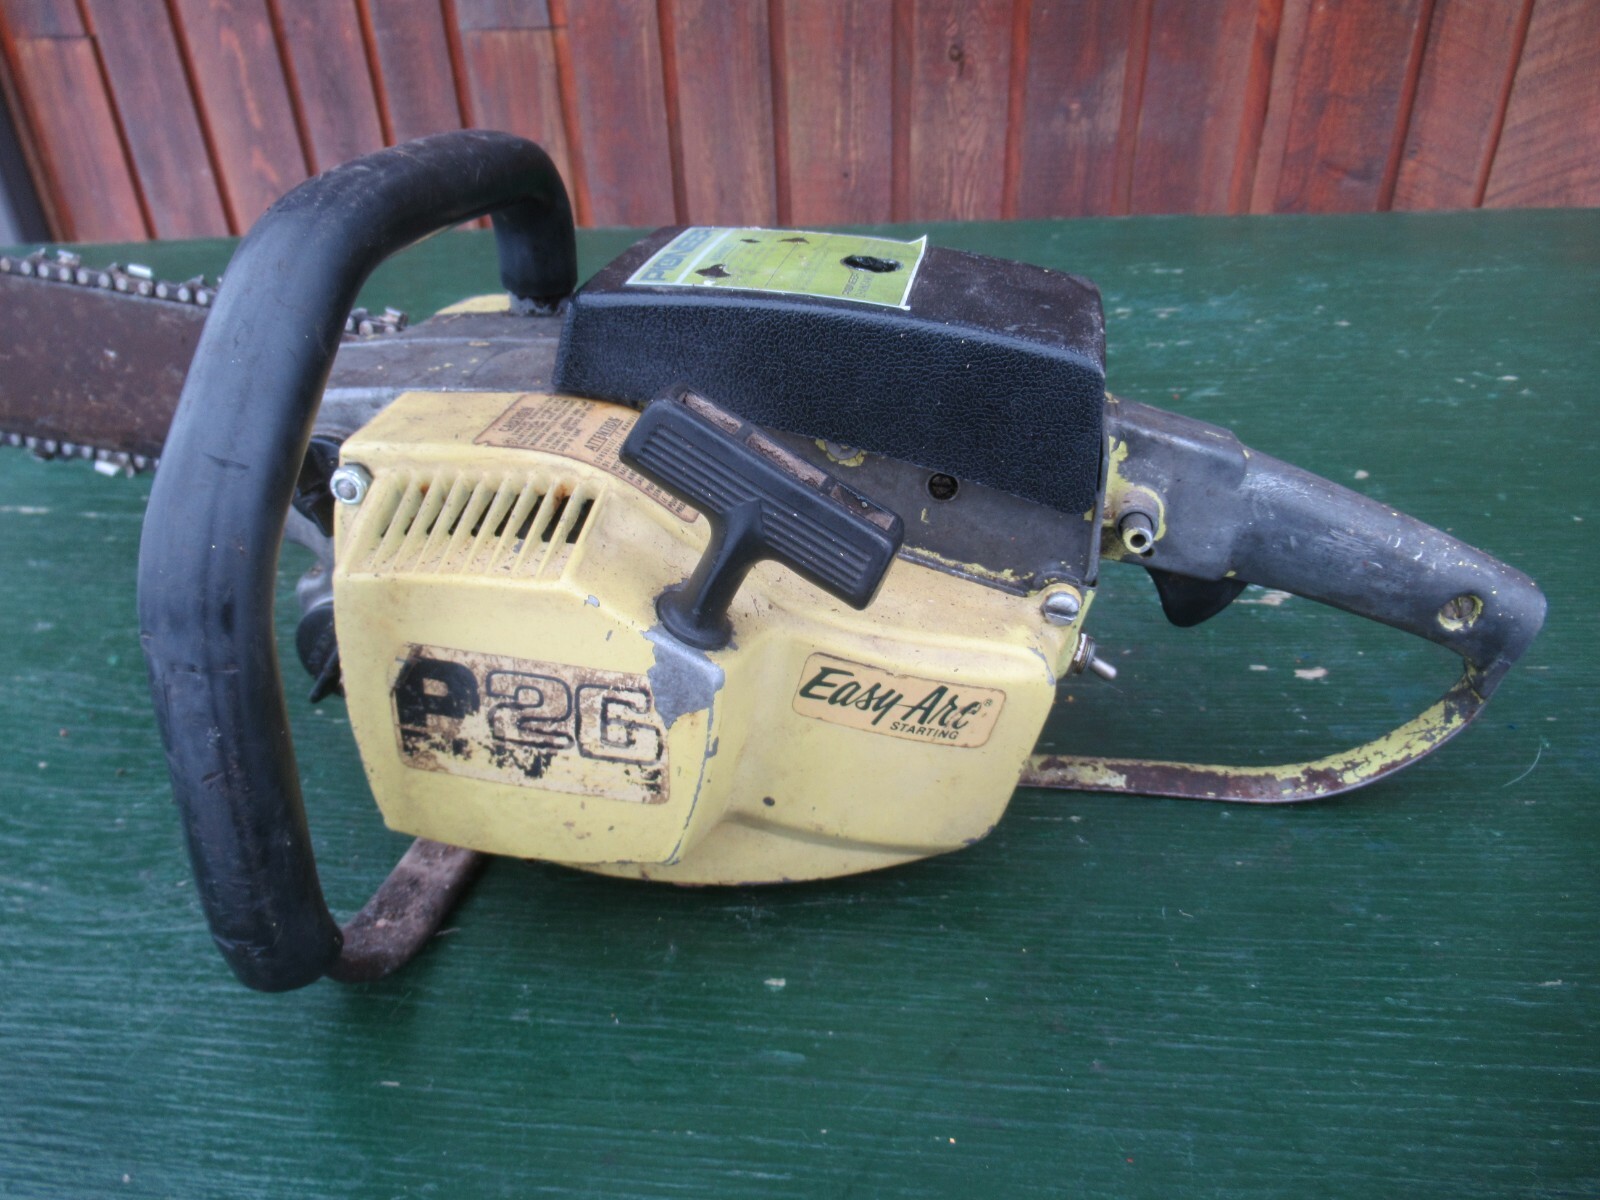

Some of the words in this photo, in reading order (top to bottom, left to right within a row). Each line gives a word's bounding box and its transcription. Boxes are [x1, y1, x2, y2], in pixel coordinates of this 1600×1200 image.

[584, 416, 622, 451] ATTENTION
[799, 666, 904, 725] Easy
[889, 721, 960, 740] STARTING
